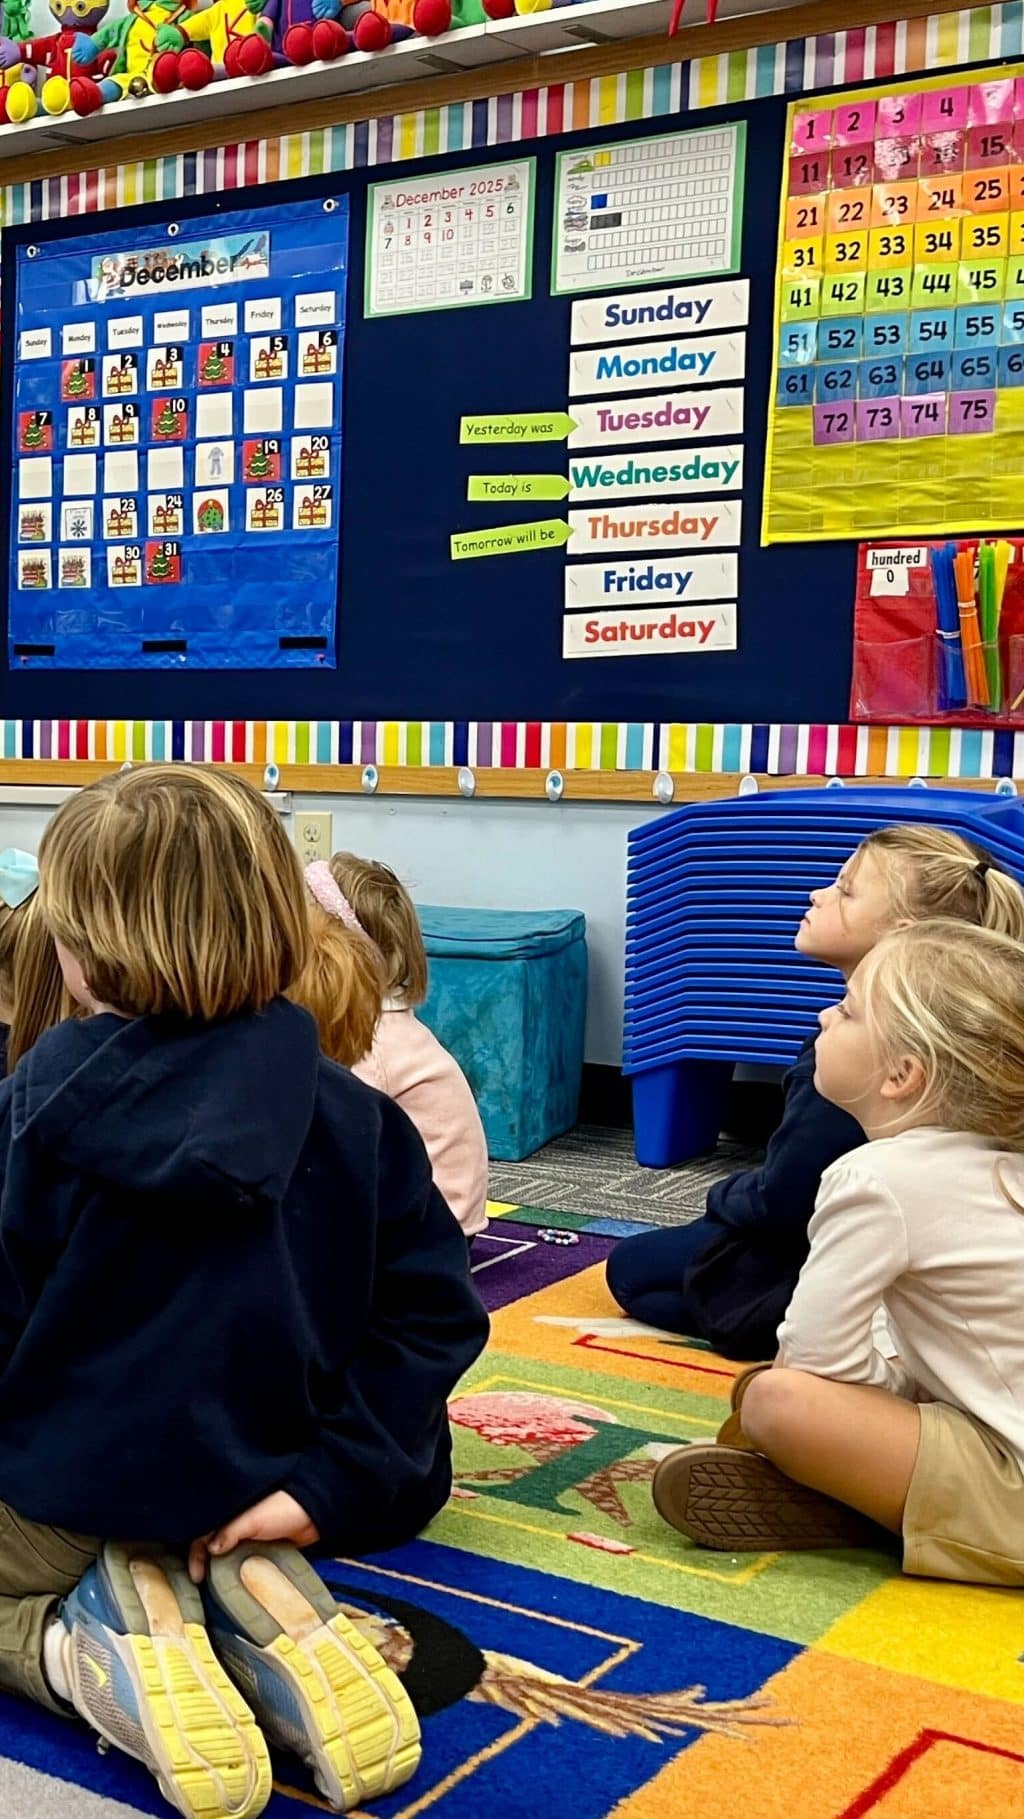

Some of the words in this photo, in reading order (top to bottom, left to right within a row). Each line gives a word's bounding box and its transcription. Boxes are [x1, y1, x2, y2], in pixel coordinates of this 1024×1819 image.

[805, 120, 815, 139] 1
[847, 112, 860, 131] 2
[940, 98, 954, 116] 4
[801, 162, 819, 183] 11
[844, 155, 867, 176] 12
[980, 135, 1004, 157] 15
[396, 187, 464, 207] December
[470, 179, 504, 196] 2025
[797, 206, 818, 228] 21
[838, 202, 864, 223] 22
[882, 195, 908, 215] 23
[928, 189, 955, 211] 24
[975, 179, 1002, 201] 25
[424, 215, 432, 227] 2
[445, 212, 451, 222] 3
[465, 209, 473, 220] 4
[485, 206, 494, 217] 5
[507, 203, 514, 214] 6
[384, 238, 392, 249] 7
[405, 236, 411, 245] 8
[424, 233, 431, 244] 9
[442, 229, 454, 241] 10
[794, 247, 815, 267] 31
[835, 241, 861, 262] 32
[879, 235, 905, 256] 33
[925, 231, 953, 252] 34
[972, 227, 1001, 248] 35
[119, 255, 238, 288] December
[790, 288, 812, 307] 41
[831, 282, 858, 301] 42
[877, 277, 904, 298] 43
[922, 272, 951, 294] 44
[969, 269, 997, 290] 45
[26, 338, 47, 347] Sunday
[68, 335, 91, 343] Monday
[113, 327, 139, 336] Tuesday
[206, 317, 233, 326] Thursday
[251, 311, 274, 319] Friday
[300, 304, 331, 314] Saturday
[604, 297, 712, 327] Sunday
[788, 333, 808, 352] 51
[828, 329, 855, 349] 52
[873, 325, 900, 345] 53
[919, 321, 947, 341] 54
[965, 316, 994, 337] 55
[125, 356, 133, 367] 2
[170, 348, 178, 361] 3
[221, 344, 230, 356] 4
[274, 338, 282, 350] 5
[323, 332, 332, 345] 6
[596, 348, 717, 379] Monday
[786, 374, 808, 394] 61
[824, 369, 852, 389] 62
[868, 364, 897, 385] 63
[915, 360, 944, 381] 64
[961, 355, 990, 376] 65
[39, 413, 47, 425] 7
[88, 408, 95, 420] 8
[126, 404, 134, 416] 9
[172, 399, 185, 412] 10
[597, 401, 711, 432] Tuesday
[823, 413, 848, 433] 72
[866, 408, 892, 428] 73
[912, 402, 938, 423] 74
[960, 399, 988, 420] 75
[466, 422, 527, 436] Yesterday
[531, 424, 553, 432] was
[264, 440, 278, 453] 19
[312, 437, 328, 449] 20
[572, 455, 739, 488] Wednesday
[121, 499, 135, 510] 23
[167, 496, 182, 508] 24
[267, 489, 282, 501] 26
[314, 486, 331, 499] 27
[483, 482, 518, 496] Today
[521, 482, 532, 493] is
[454, 537, 512, 552] Tomorrow
[515, 530, 536, 544] will
[540, 529, 555, 540] be
[588, 511, 719, 540] Thursday
[126, 547, 139, 558] 30
[165, 543, 176, 555] 31
[872, 550, 920, 565] hundred
[604, 566, 693, 594] Friday
[584, 615, 715, 643] Saturday
